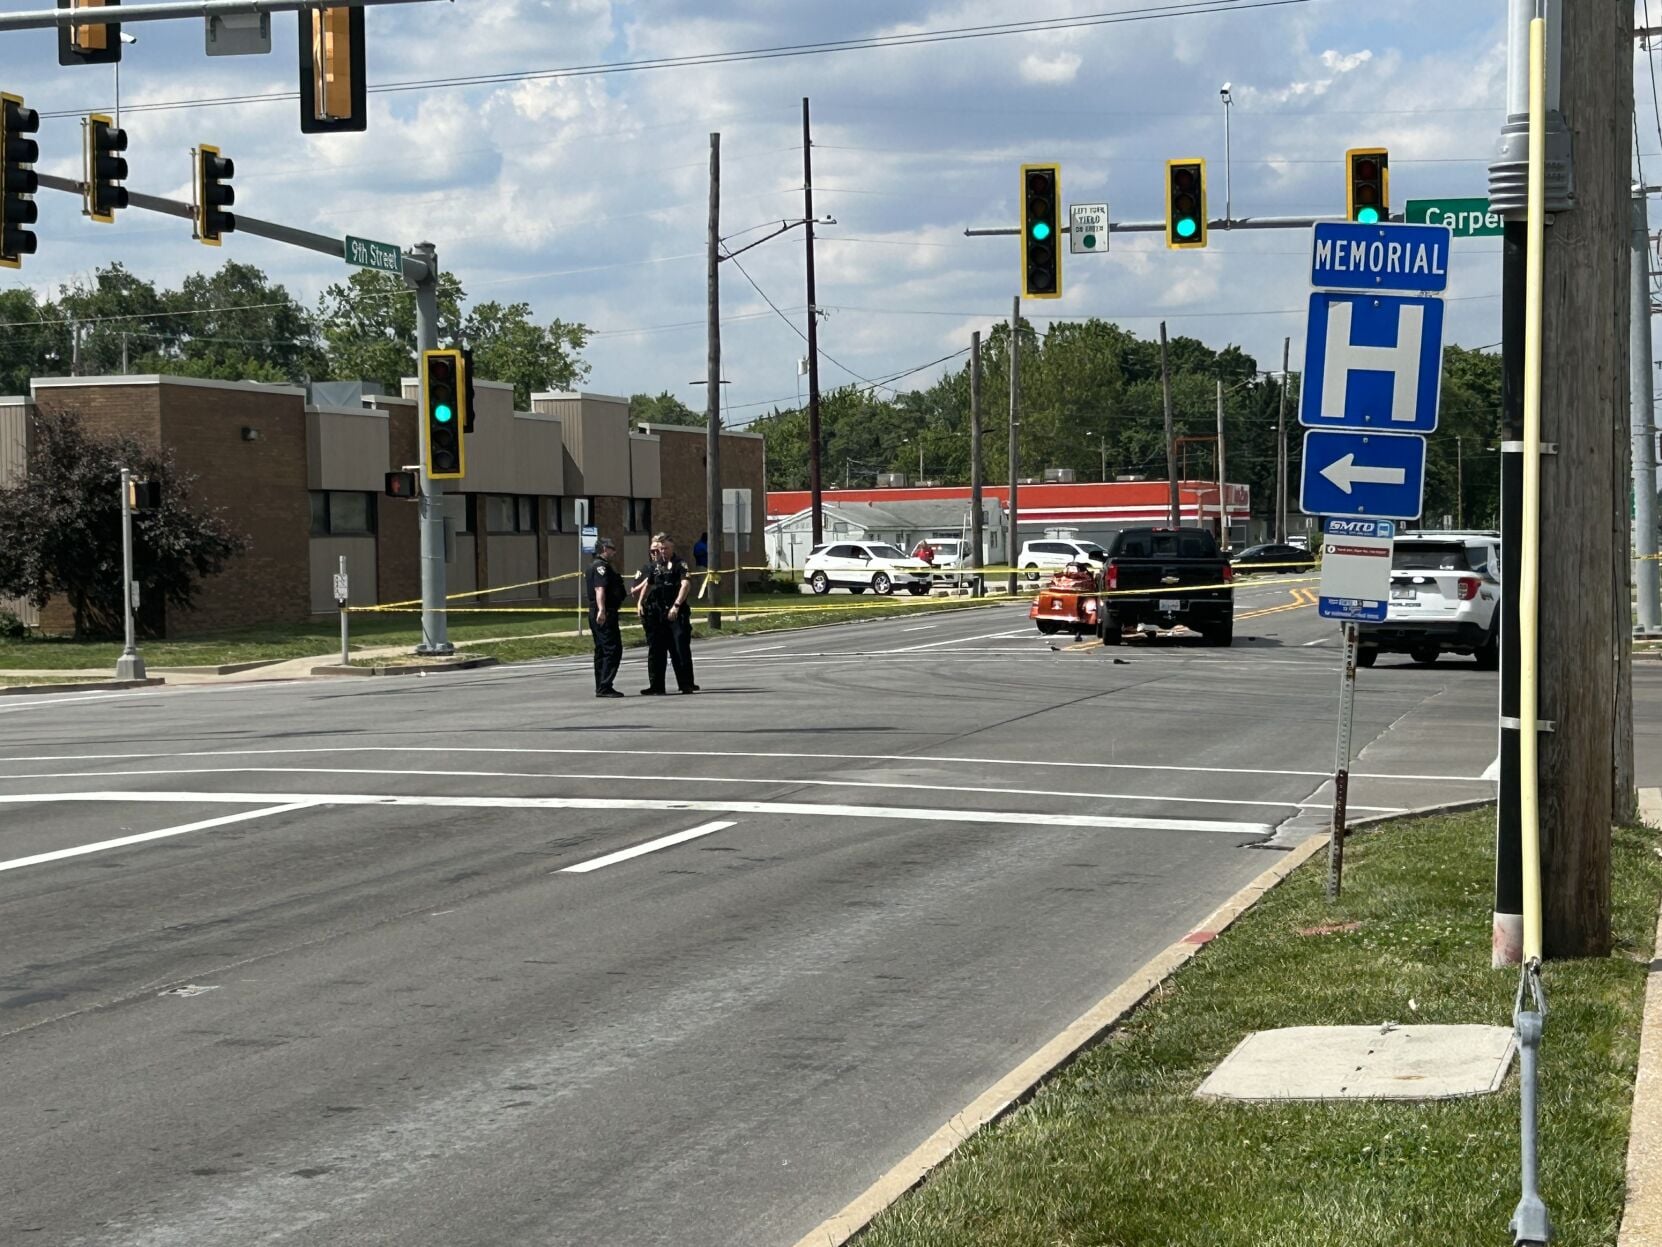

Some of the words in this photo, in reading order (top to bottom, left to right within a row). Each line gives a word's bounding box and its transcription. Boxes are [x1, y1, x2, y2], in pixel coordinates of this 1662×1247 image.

[1073, 207, 1087, 215] LEFT
[1079, 215, 1100, 224] YIELD
[351, 240, 368, 264] 9th
[370, 244, 398, 270] Street
[1315, 239, 1445, 275] MEMORIAL
[1320, 301, 1425, 422] H
[1328, 520, 1375, 532] SMTD
